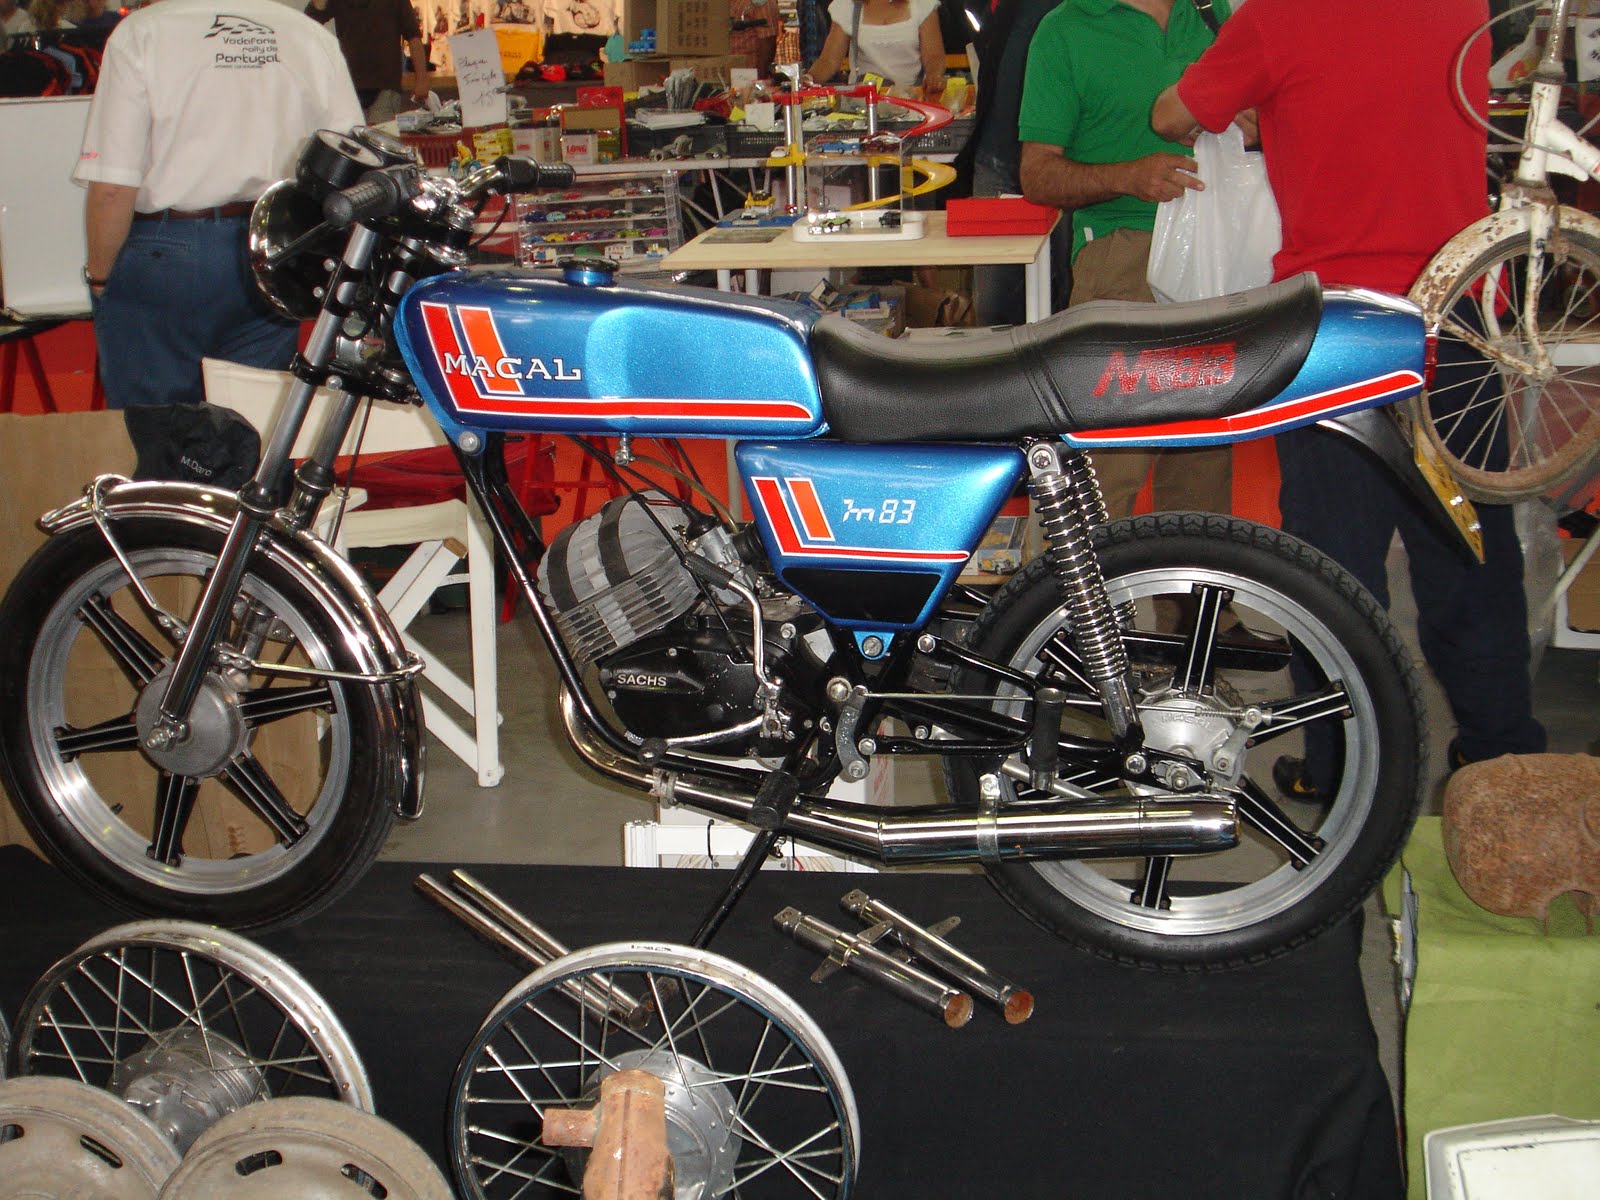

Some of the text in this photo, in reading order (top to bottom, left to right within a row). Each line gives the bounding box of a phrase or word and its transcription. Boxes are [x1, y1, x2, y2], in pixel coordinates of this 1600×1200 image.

[223, 37, 277, 45] Vodafone
[215, 53, 281, 65] Portugal
[566, 144, 588, 155] LONG
[443, 352, 582, 381] MACAL
[617, 673, 667, 687] SACHS
